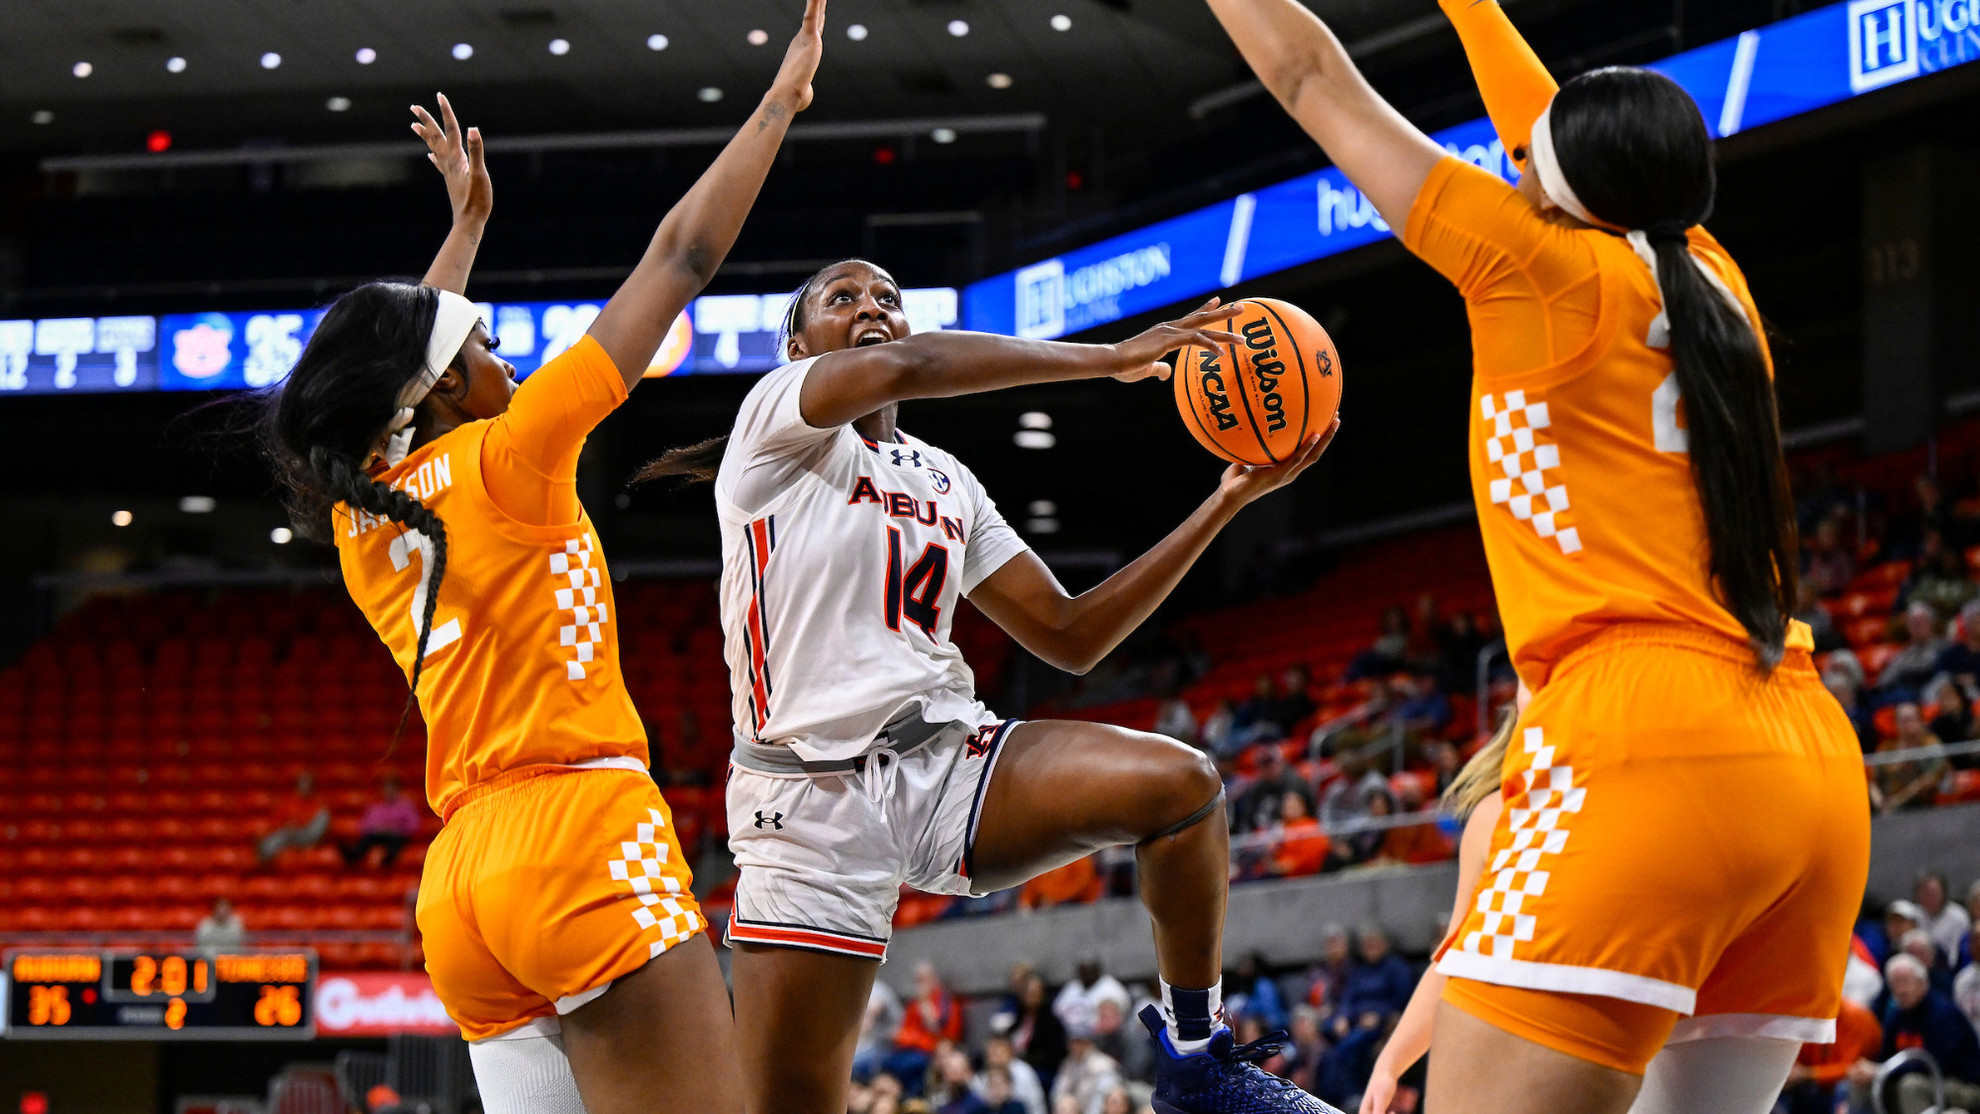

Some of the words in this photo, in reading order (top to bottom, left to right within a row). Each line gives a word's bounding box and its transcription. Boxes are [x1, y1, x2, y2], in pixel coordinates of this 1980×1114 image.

[1199, 350, 1239, 432] NCAA
[1241, 316, 1287, 434] Wilson
[389, 527, 462, 658] 2
[884, 525, 949, 646] 14
